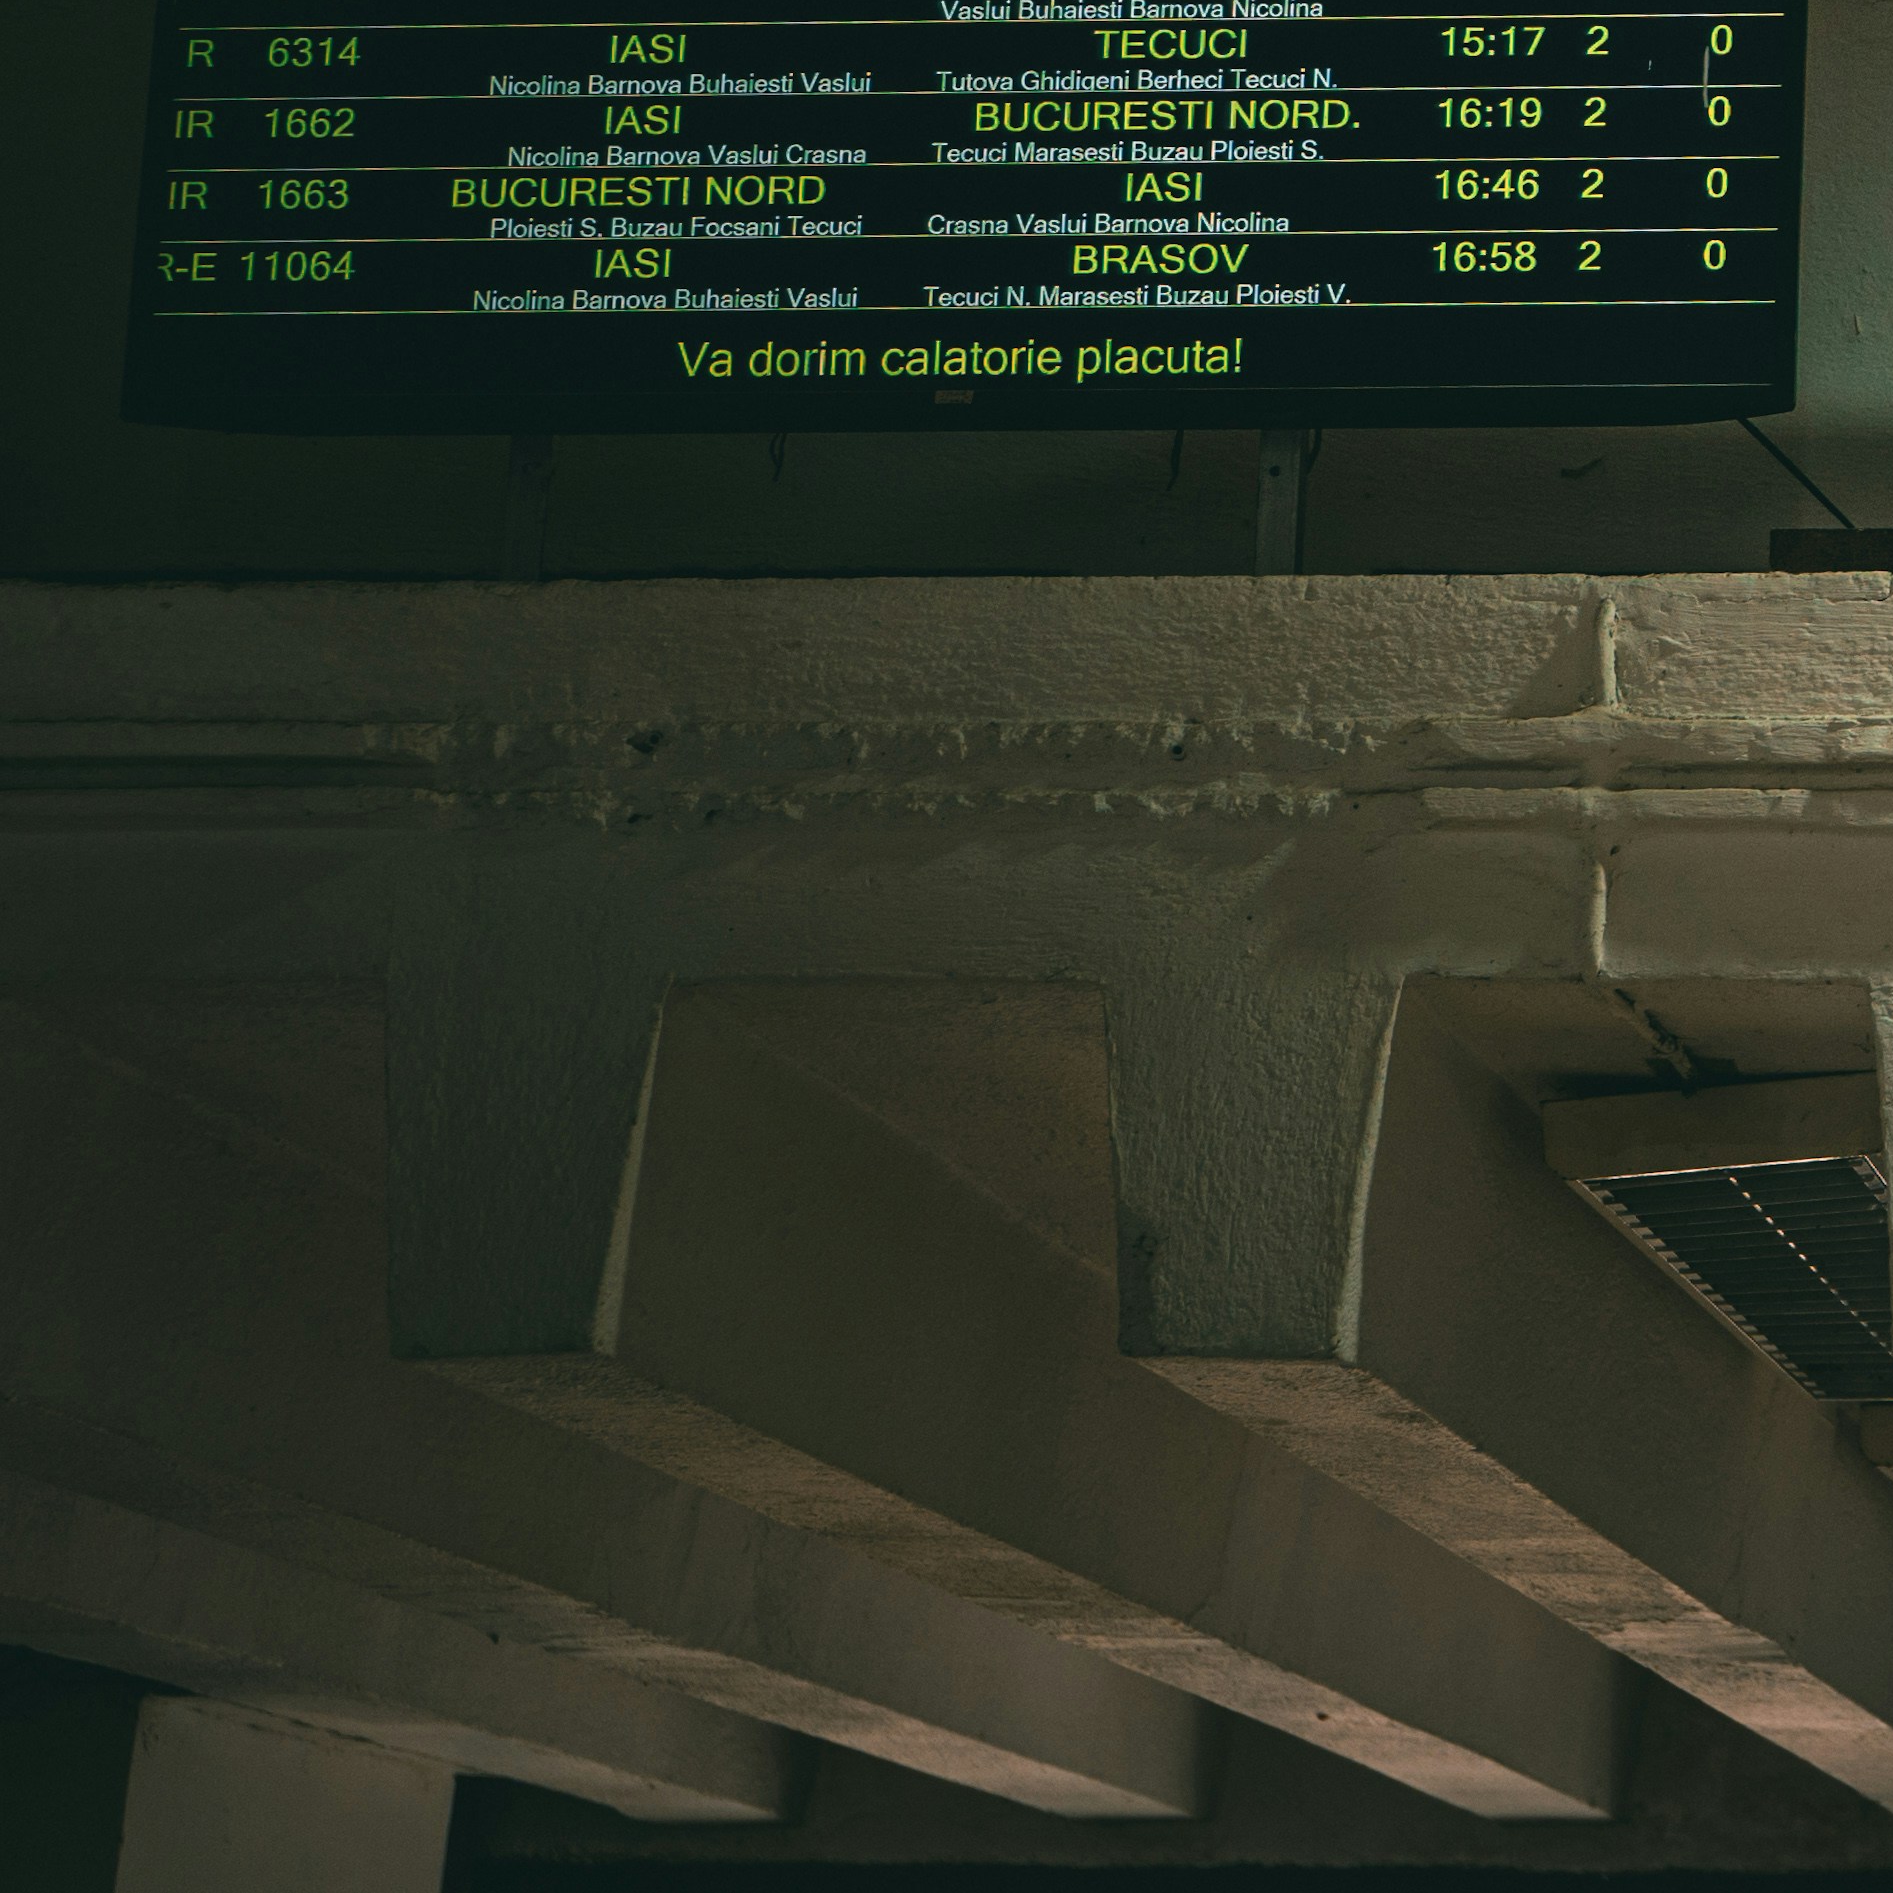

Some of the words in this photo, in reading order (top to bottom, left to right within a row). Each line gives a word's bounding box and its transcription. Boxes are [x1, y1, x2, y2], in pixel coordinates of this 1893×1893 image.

[240, 250, 355, 282] 11064
[595, 247, 672, 279] IASI
[1073, 243, 1250, 275] BRASOV
[1432, 240, 1537, 273] 16:58
[1578, 240, 1602, 271] 2
[1703, 239, 1727, 271] 0
[473, 289, 565, 311] Nicolina
[572, 289, 667, 311] Barnova
[674, 287, 780, 311] Buhaiesti
[786, 286, 858, 311] Vaslui
[923, 285, 999, 309] Tecuci
[1007, 285, 1032, 306] N.
[1039, 284, 1149, 306] Marasesti
[1156, 284, 1229, 306] Buzau
[1236, 283, 1320, 306] Ploiesti
[1326, 283, 1353, 306] V.
[677, 341, 733, 378] Va
[748, 340, 866, 377] dorim
[881, 338, 1062, 376] calatorie
[1077, 337, 1242, 384] placuta!
